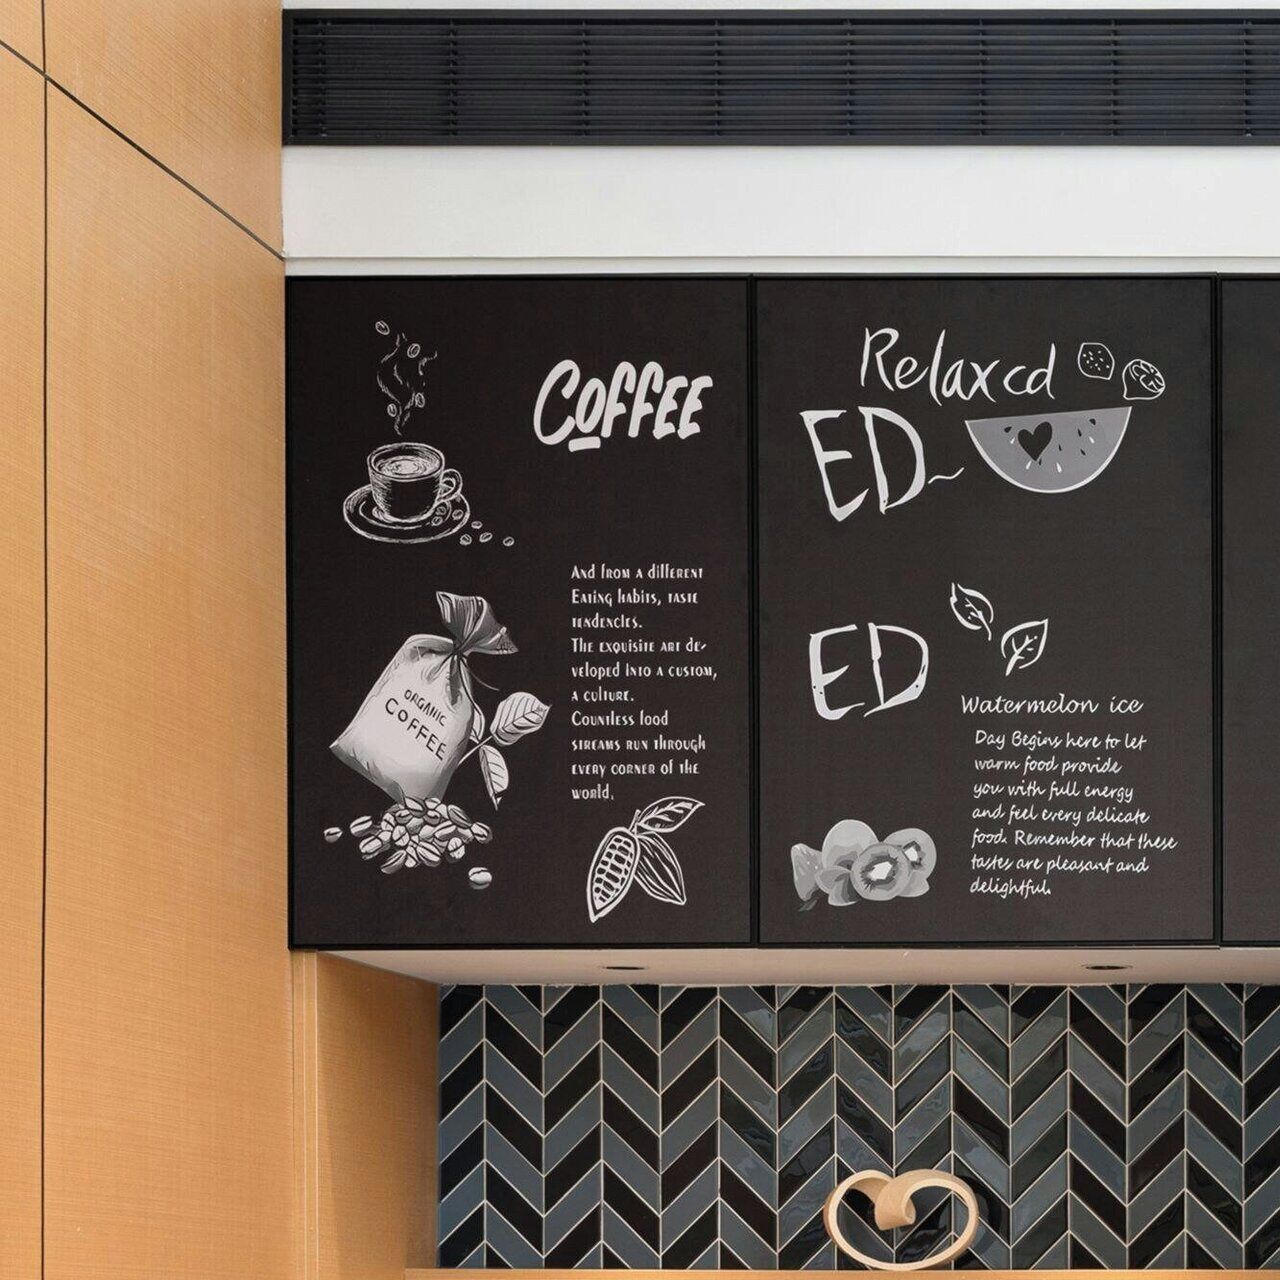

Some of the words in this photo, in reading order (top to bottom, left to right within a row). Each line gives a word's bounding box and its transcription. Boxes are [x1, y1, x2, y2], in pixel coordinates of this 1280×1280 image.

[809, 622, 929, 721] ED
[403, 689, 447, 727] ORGANIC
[962, 693, 1099, 713] Watermelon
[1110, 696, 1144, 713] ice
[976, 730, 1005, 750] Day
[1012, 730, 1062, 751] Begins
[1066, 732, 1102, 748] here
[1105, 734, 1121, 750] to
[1125, 734, 1147, 750] let
[975, 759, 1020, 770] warm
[1023, 755, 1058, 775] food
[1062, 757, 1122, 776] provide
[974, 784, 1004, 798] you
[1008, 780, 1046, 796] with
[1048, 781, 1080, 801] full
[1085, 786, 1133, 803] energy
[972, 804, 1005, 819] and
[1008, 804, 1038, 825] feel
[1042, 809, 1081, 826] every
[1087, 806, 1150, 824] delicate
[972, 828, 1007, 848] food.
[1015, 830, 1095, 847] Remember
[1100, 832, 1135, 849] that
[1138, 833, 1178, 851] these
[971, 854, 1014, 870] tastes
[1016, 858, 1044, 870] are
[1046, 855, 1114, 874] pleasant
[1116, 857, 1149, 873] and
[970, 876, 1051, 899] delightful.
